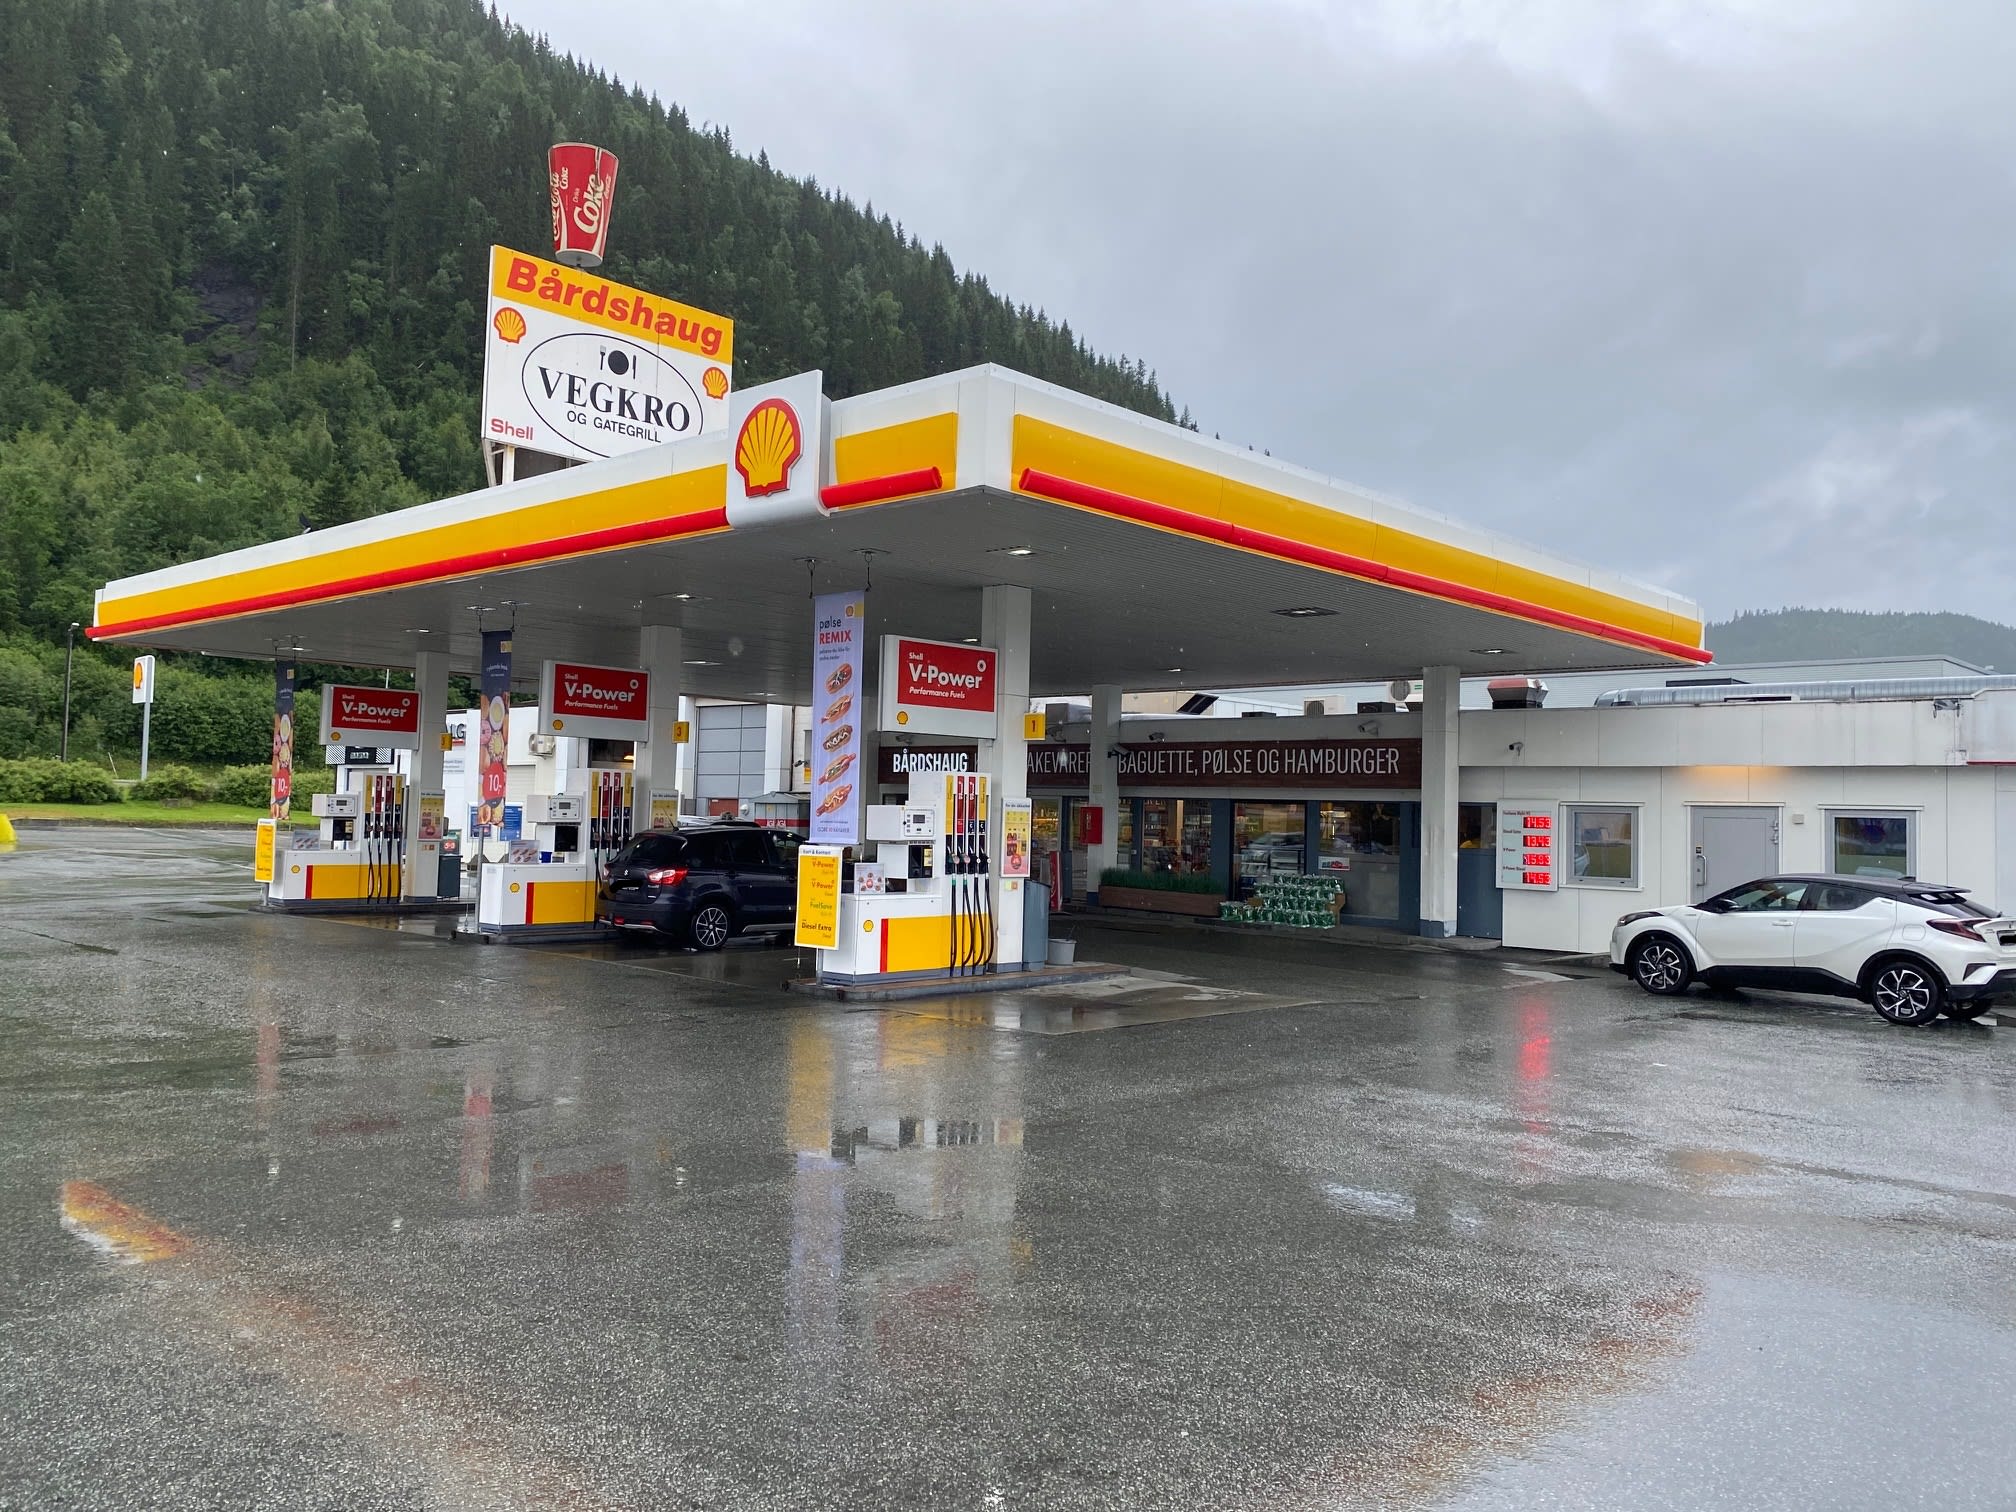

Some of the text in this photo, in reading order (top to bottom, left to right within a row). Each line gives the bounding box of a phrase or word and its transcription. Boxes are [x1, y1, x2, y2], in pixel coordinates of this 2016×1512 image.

[573, 173, 605, 235] Coke
[506, 257, 723, 356] Bårdshaug
[537, 366, 691, 432] VEGKRO
[490, 417, 534, 441] Shell
[567, 410, 662, 443] OG GATEGRILL
[819, 616, 842, 632] pølse
[819, 630, 852, 645] REMIX
[908, 652, 924, 660] Shell
[564, 673, 579, 681] Shell
[908, 662, 983, 689] V-Power
[564, 681, 636, 703] V-Power
[908, 686, 966, 699] Performance Fuels
[341, 701, 407, 718] V-Power
[564, 699, 602, 710] Performance
[676, 726, 682, 738] 3
[1031, 719, 1036, 733] 1
[892, 748, 969, 773] BÅRDSHAUG
[1118, 750, 1198, 776] BAGUETTE,
[1202, 747, 1253, 775] PØLSE
[1257, 749, 1280, 774] OG
[1284, 748, 1400, 775] HAMBURGER
[811, 881, 834, 889] V-Power
[801, 922, 817, 930] Diesel
